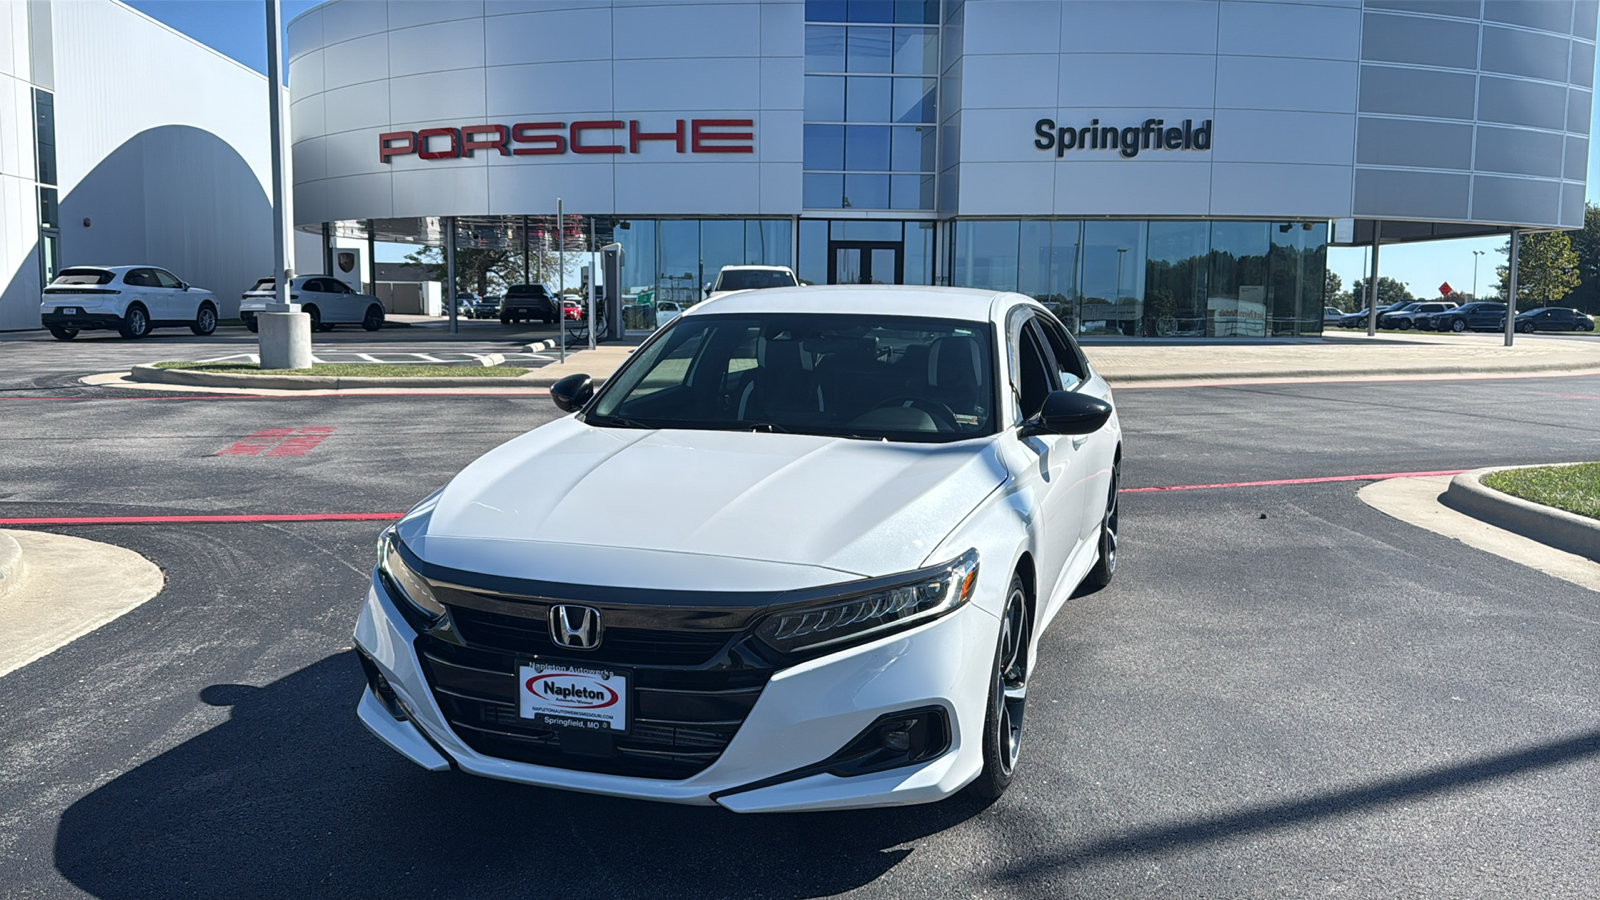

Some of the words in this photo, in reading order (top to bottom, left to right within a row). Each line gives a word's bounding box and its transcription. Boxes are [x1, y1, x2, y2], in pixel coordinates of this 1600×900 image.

[379, 119, 753, 163] PORSCHE
[1034, 118, 1212, 158] Springfield
[529, 662, 566, 671] Napleton
[569, 666, 614, 676] Autowerks
[543, 681, 604, 700] Napleton
[544, 716, 585, 728] Springfield,
[587, 721, 600, 729] MO
